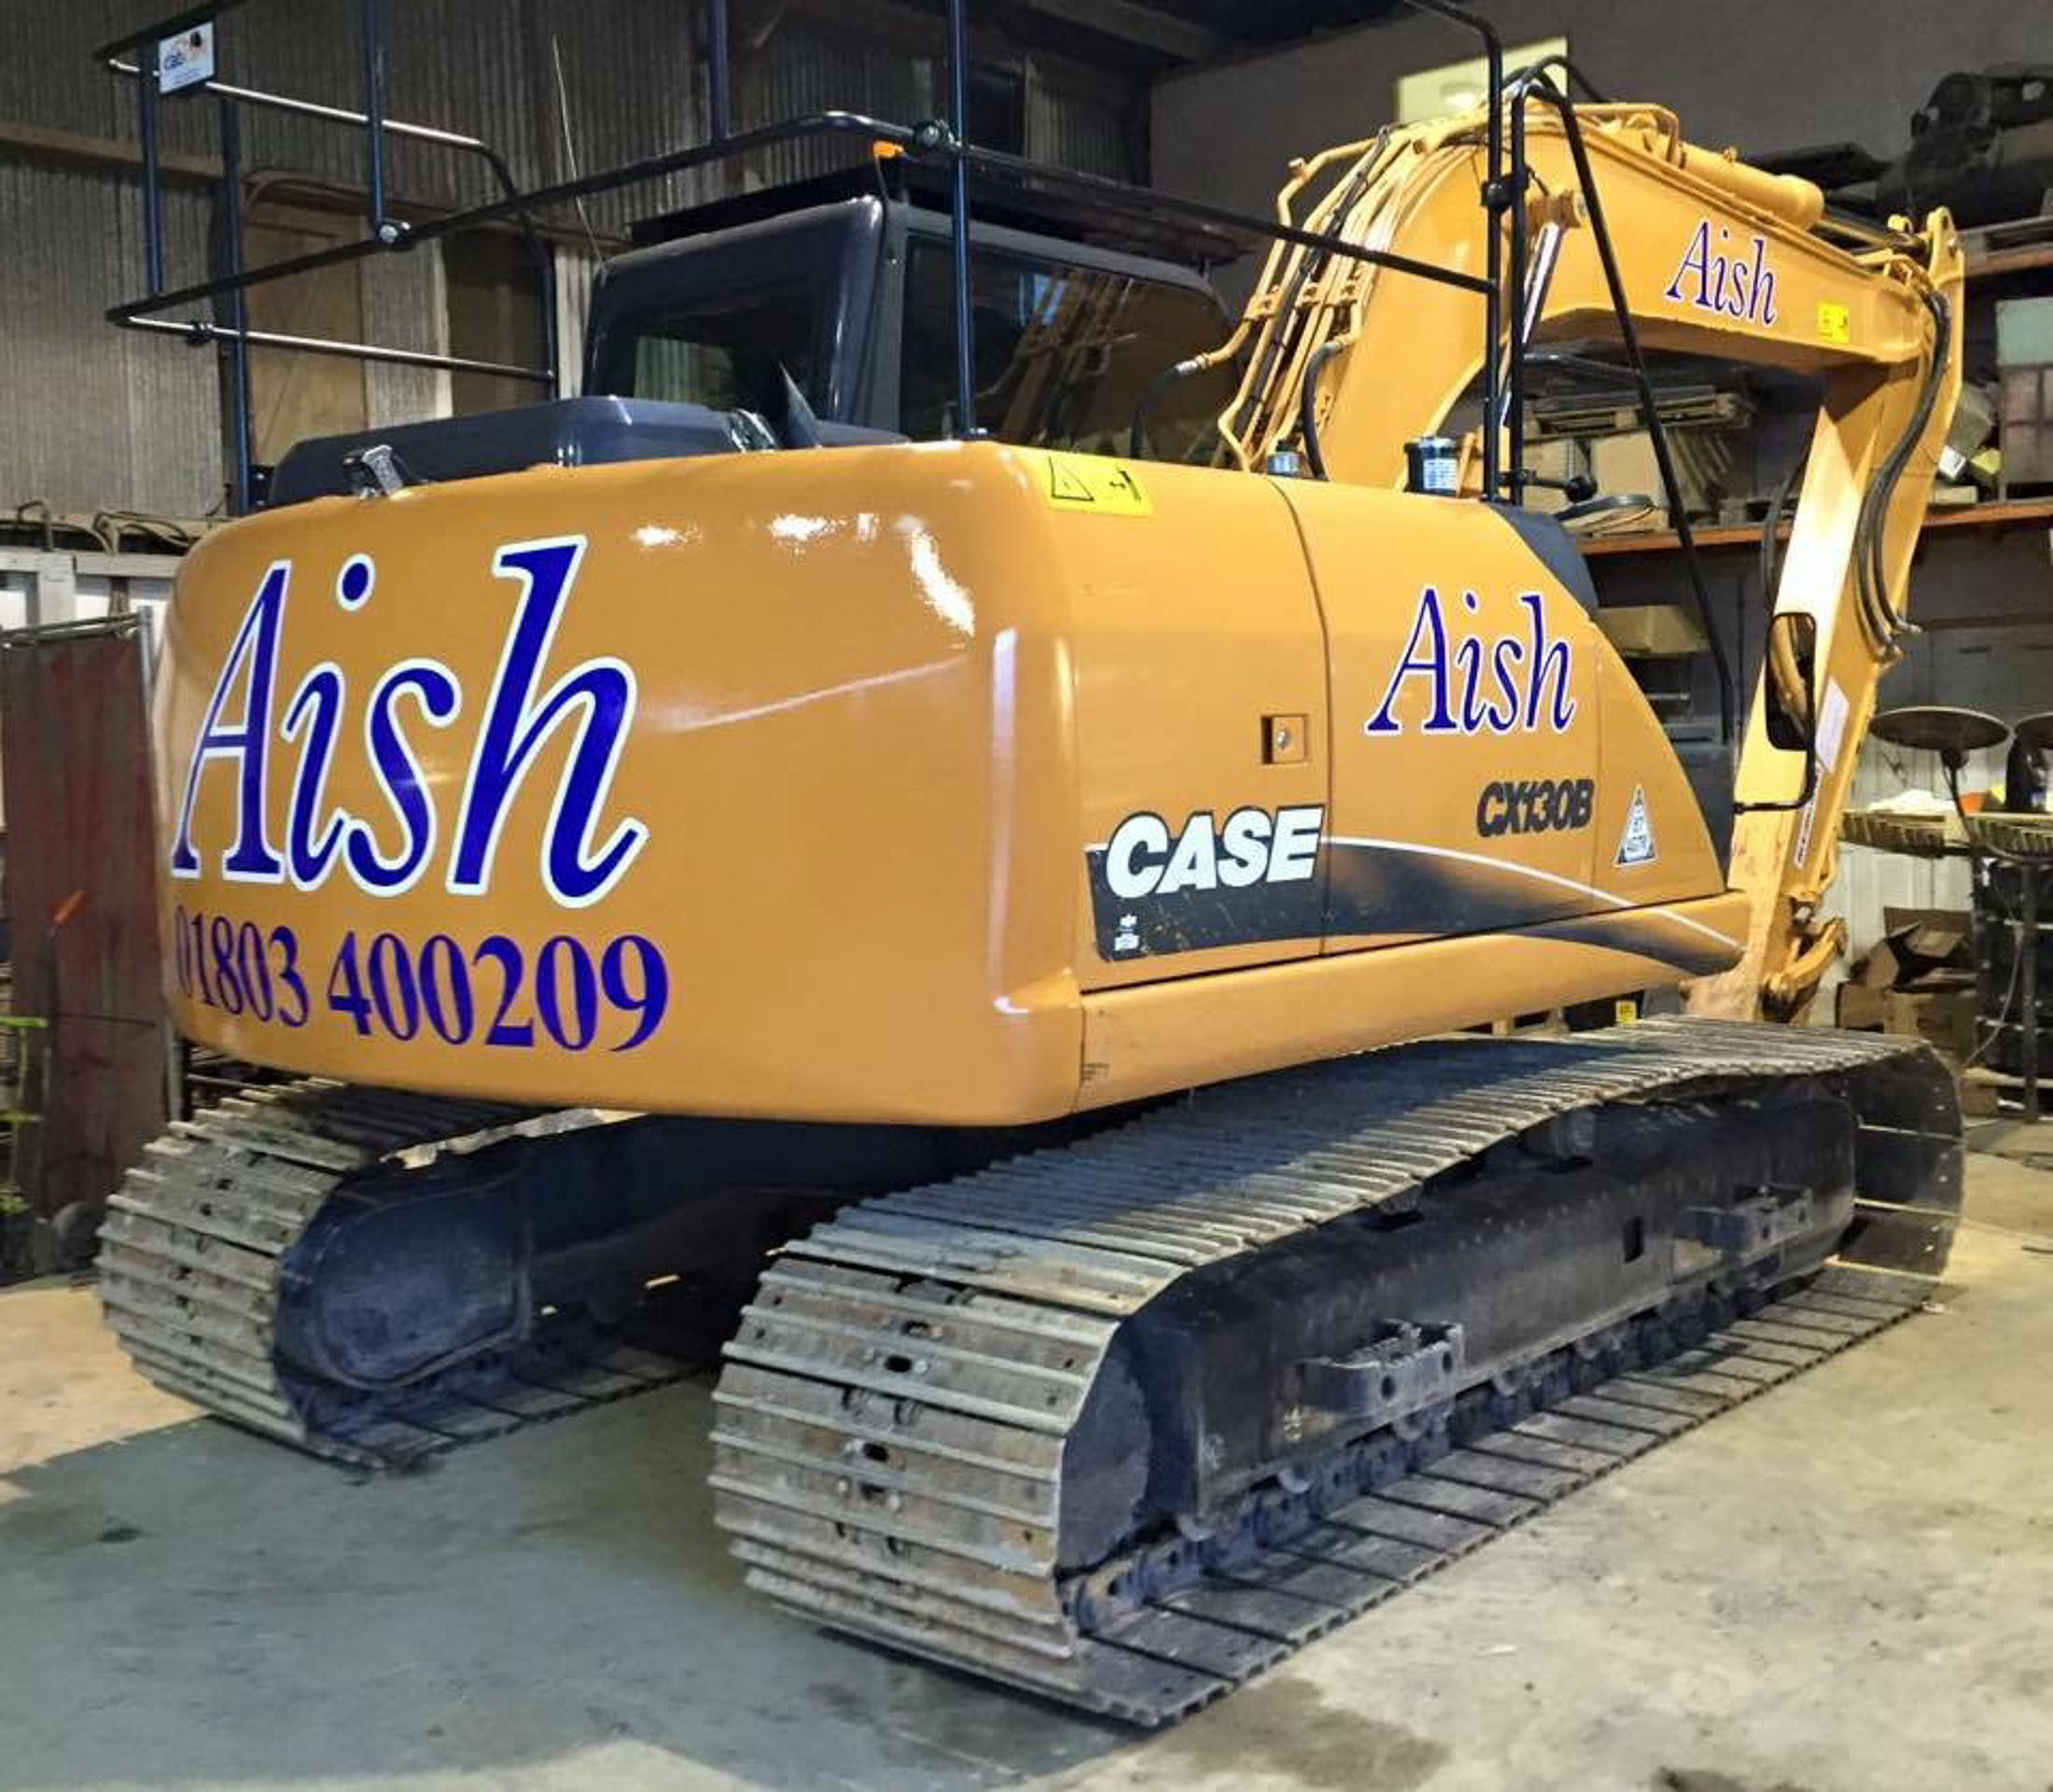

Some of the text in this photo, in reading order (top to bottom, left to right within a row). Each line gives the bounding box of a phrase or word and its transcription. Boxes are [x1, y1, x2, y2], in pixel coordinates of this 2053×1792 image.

[1666, 220, 1777, 326] Aish
[172, 535, 649, 909] Aish
[1365, 584, 1577, 735] Aish
[1106, 805, 1325, 899] CASE
[1476, 779, 1594, 837] CX130B
[175, 904, 669, 1052] 01803 400209
